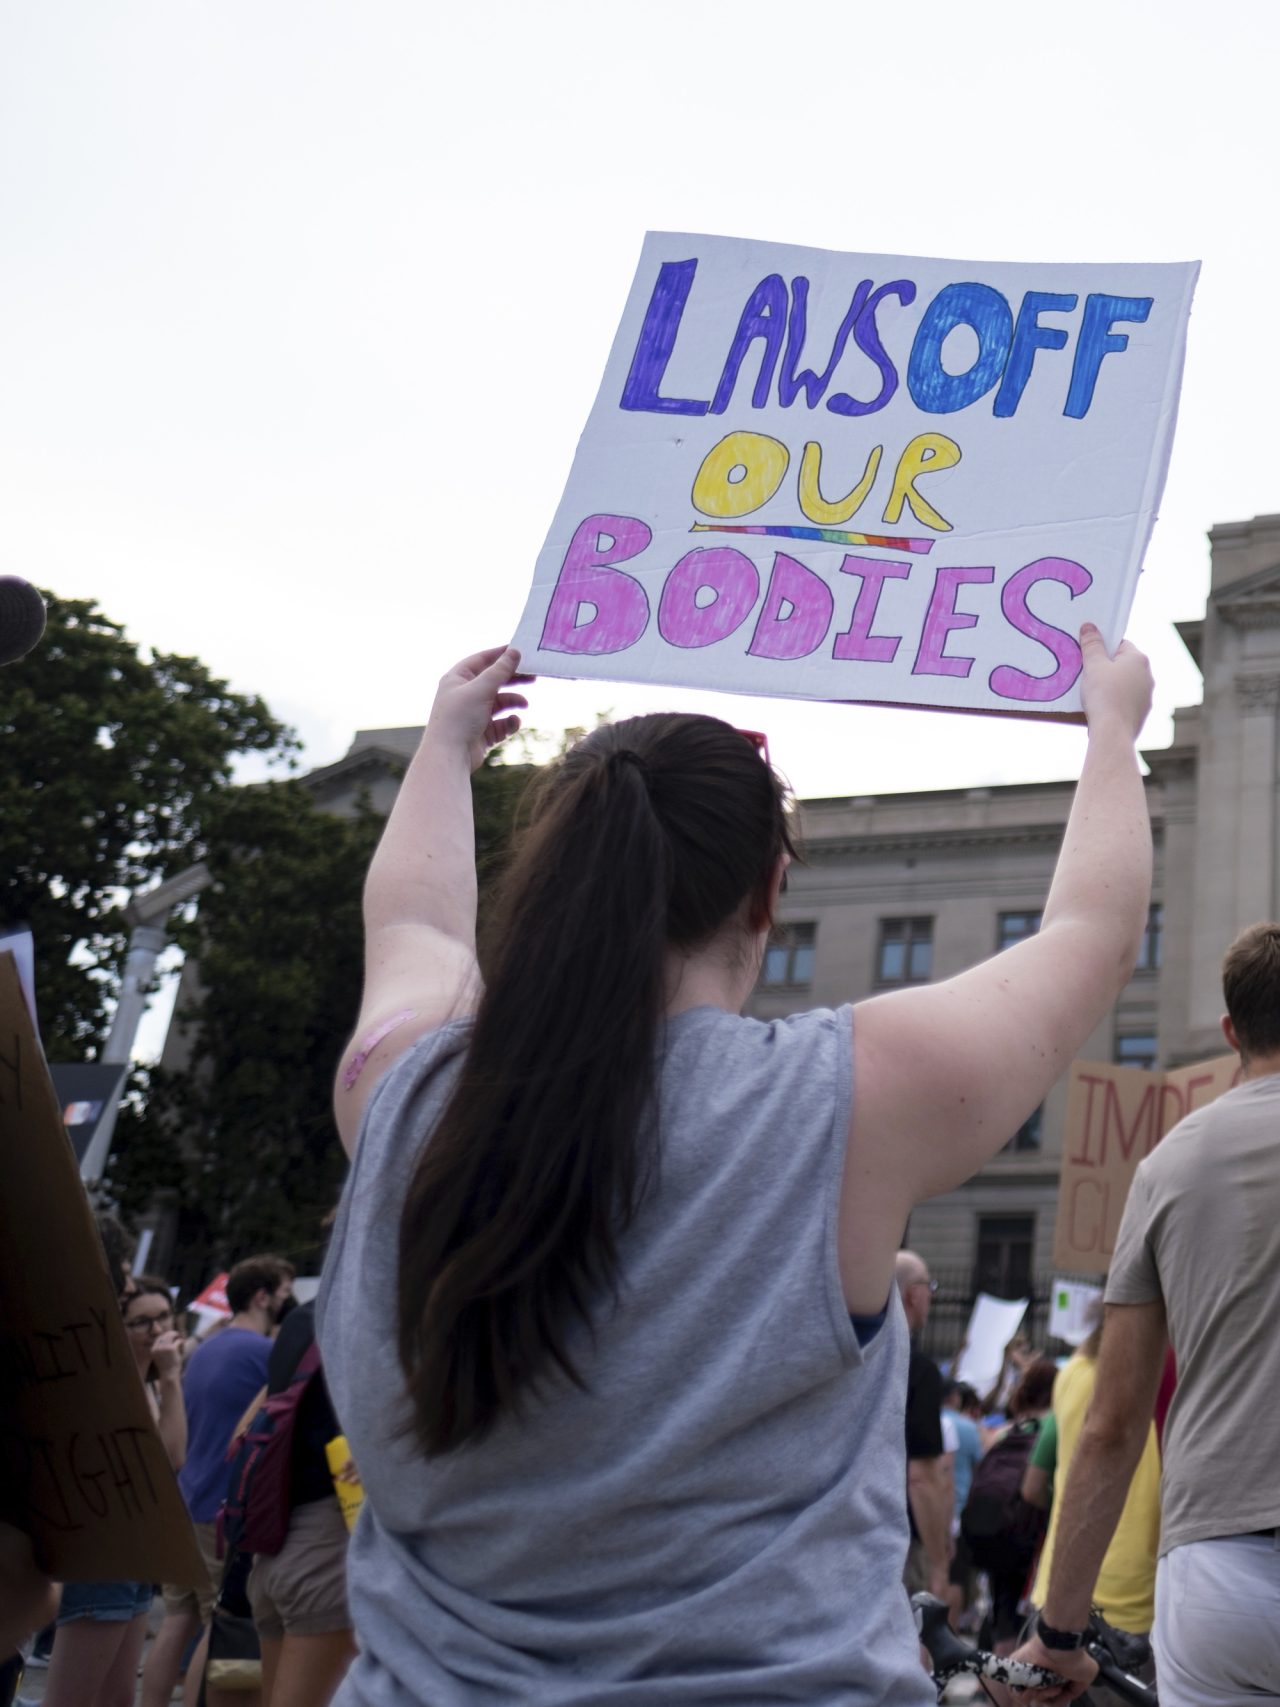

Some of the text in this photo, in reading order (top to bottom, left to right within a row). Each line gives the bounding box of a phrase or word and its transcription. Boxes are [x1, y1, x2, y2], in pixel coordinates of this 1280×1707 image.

[619, 257, 1154, 419] LAWS OFF
[691, 430, 962, 532] OUR
[538, 513, 1093, 702] BODIES
